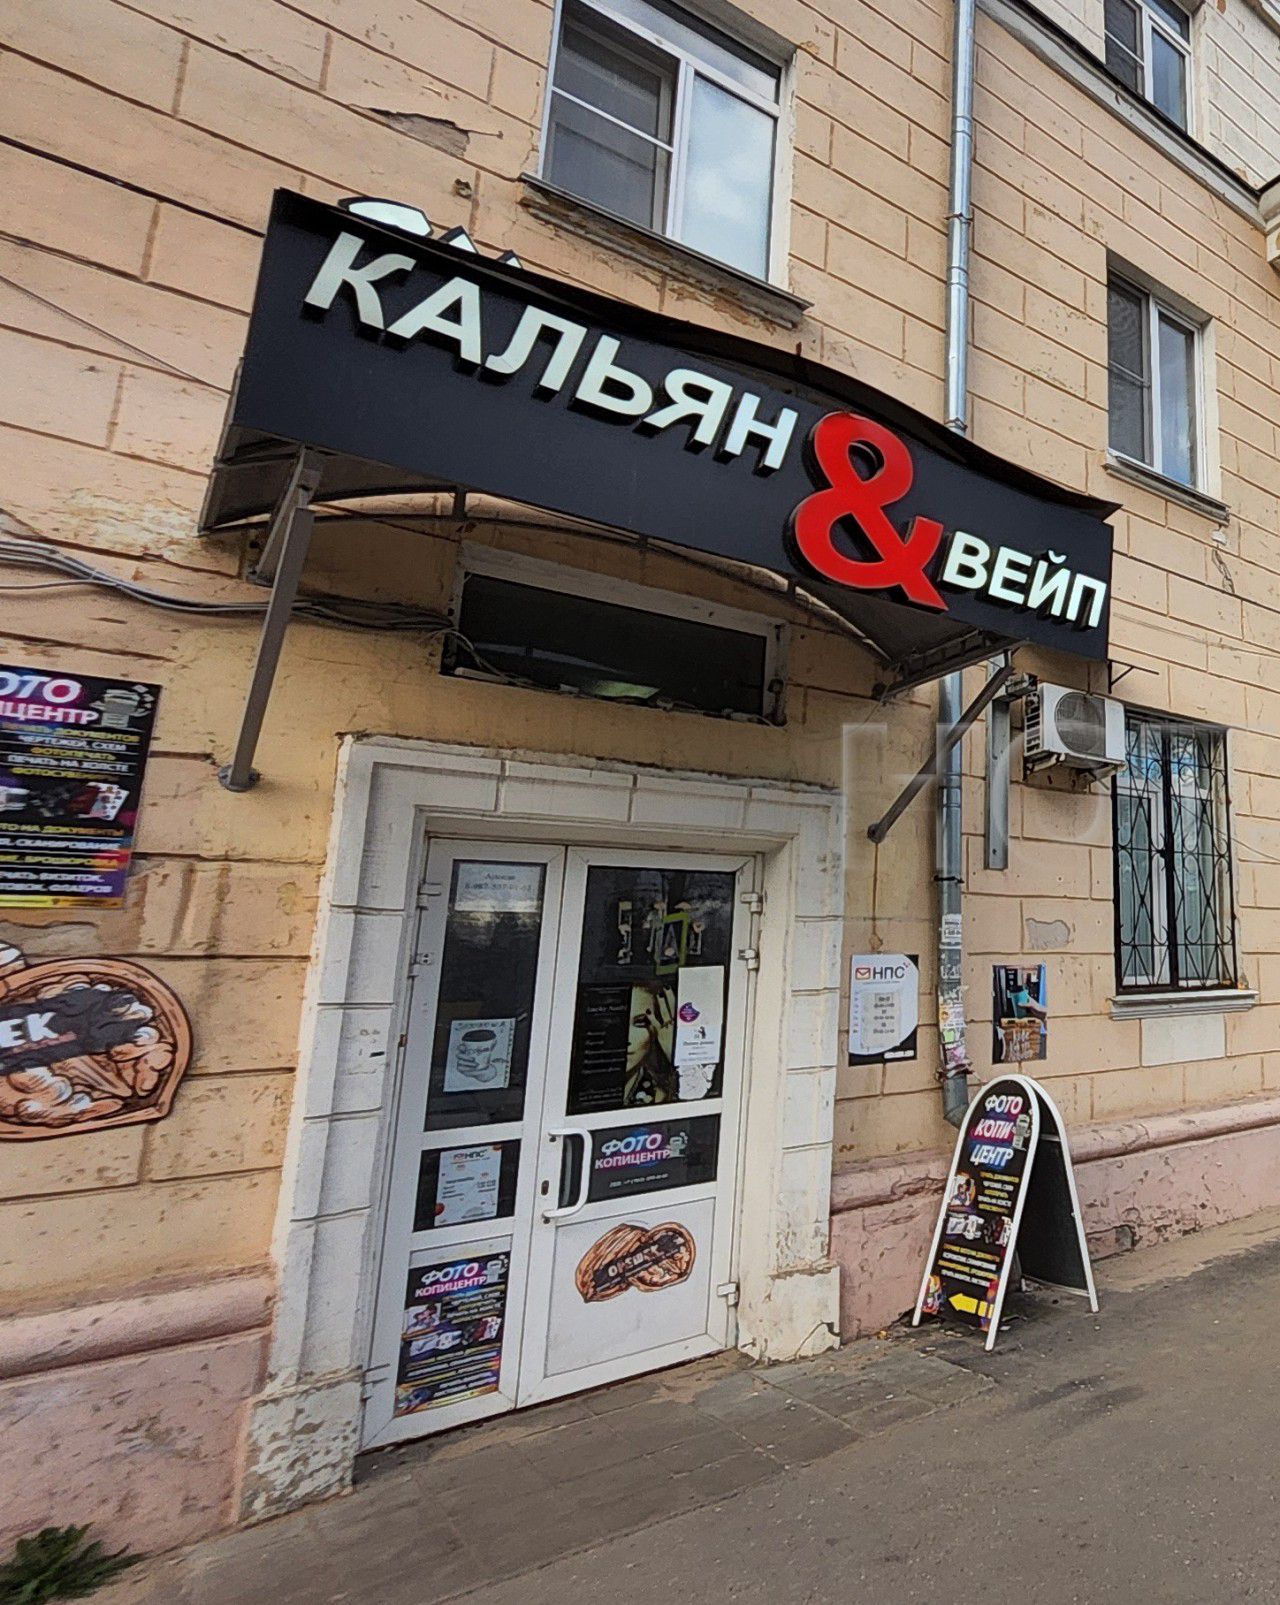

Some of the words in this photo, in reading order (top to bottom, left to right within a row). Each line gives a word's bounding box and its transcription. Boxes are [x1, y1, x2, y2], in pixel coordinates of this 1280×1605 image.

[304, 231, 798, 470] КАЛЬЯН
[795, 410, 949, 612] &
[942, 531, 1107, 628] ВЕЙП
[873, 966, 905, 980] НПС
[985, 1095, 1023, 1114] ФОТО
[974, 1119, 1014, 1139] КОПИ
[601, 1133, 662, 1156] ФОТО
[594, 1149, 671, 1170] КОПИЦЕНТР
[970, 1145, 1014, 1166] ЦЕНТР
[421, 1262, 479, 1285] ФОТО
[415, 1276, 487, 1297] КОПИЦЕНТР
